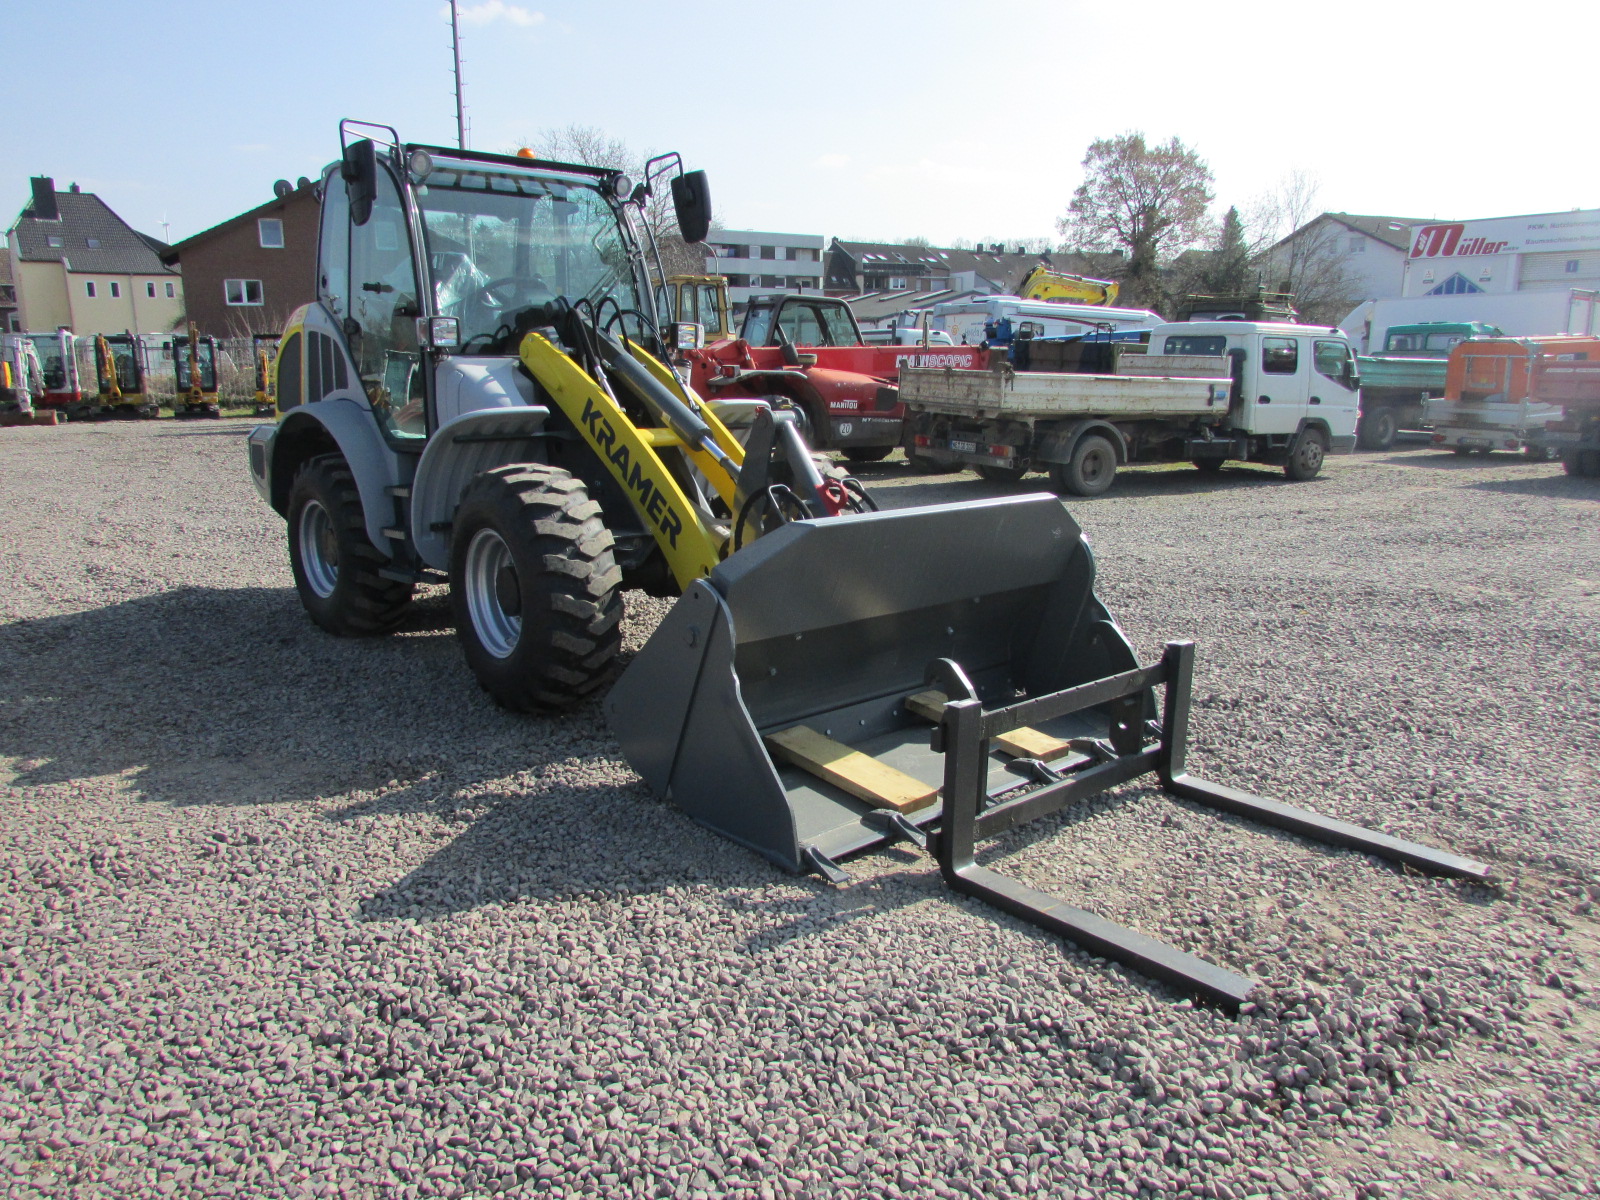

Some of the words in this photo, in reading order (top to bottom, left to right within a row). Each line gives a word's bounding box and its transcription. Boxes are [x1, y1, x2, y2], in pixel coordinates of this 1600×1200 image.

[1410, 224, 1508, 258] Müller
[830, 400, 858, 409] MANITOU
[841, 424, 851, 434] 20
[581, 397, 682, 551] KRAMER
